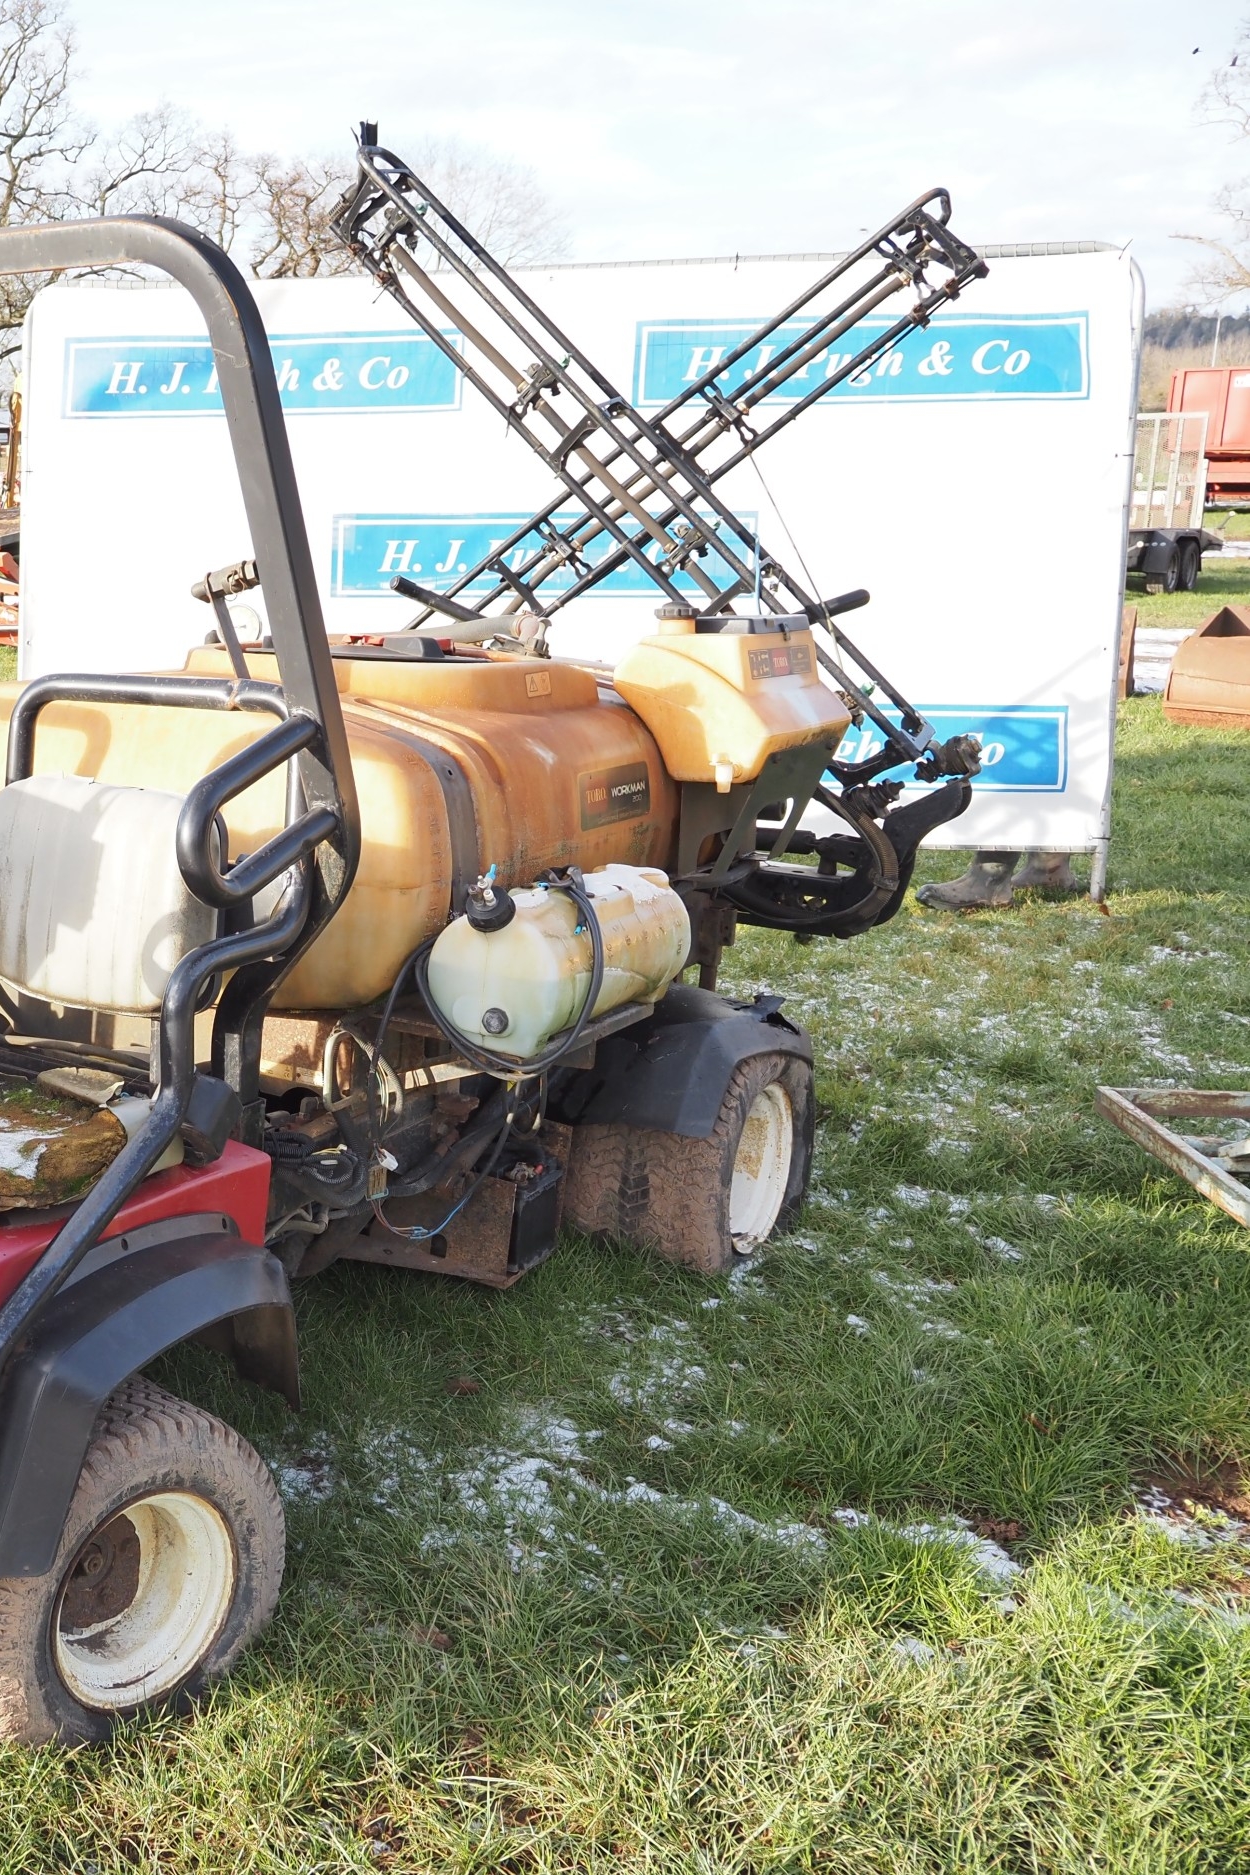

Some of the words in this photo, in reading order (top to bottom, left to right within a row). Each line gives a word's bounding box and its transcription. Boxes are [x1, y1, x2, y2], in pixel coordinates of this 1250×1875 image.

[105, 361, 148, 394] H.
[159, 362, 191, 394] J.
[312, 357, 344, 391] &
[359, 356, 410, 390] Co
[682, 346, 730, 380] H.
[918, 340, 954, 376] &
[971, 339, 1031, 376] Co
[377, 539, 422, 573] H.
[436, 539, 467, 573] J.
[585, 786, 608, 804] TORO
[611, 780, 646, 798] WORKMAN
